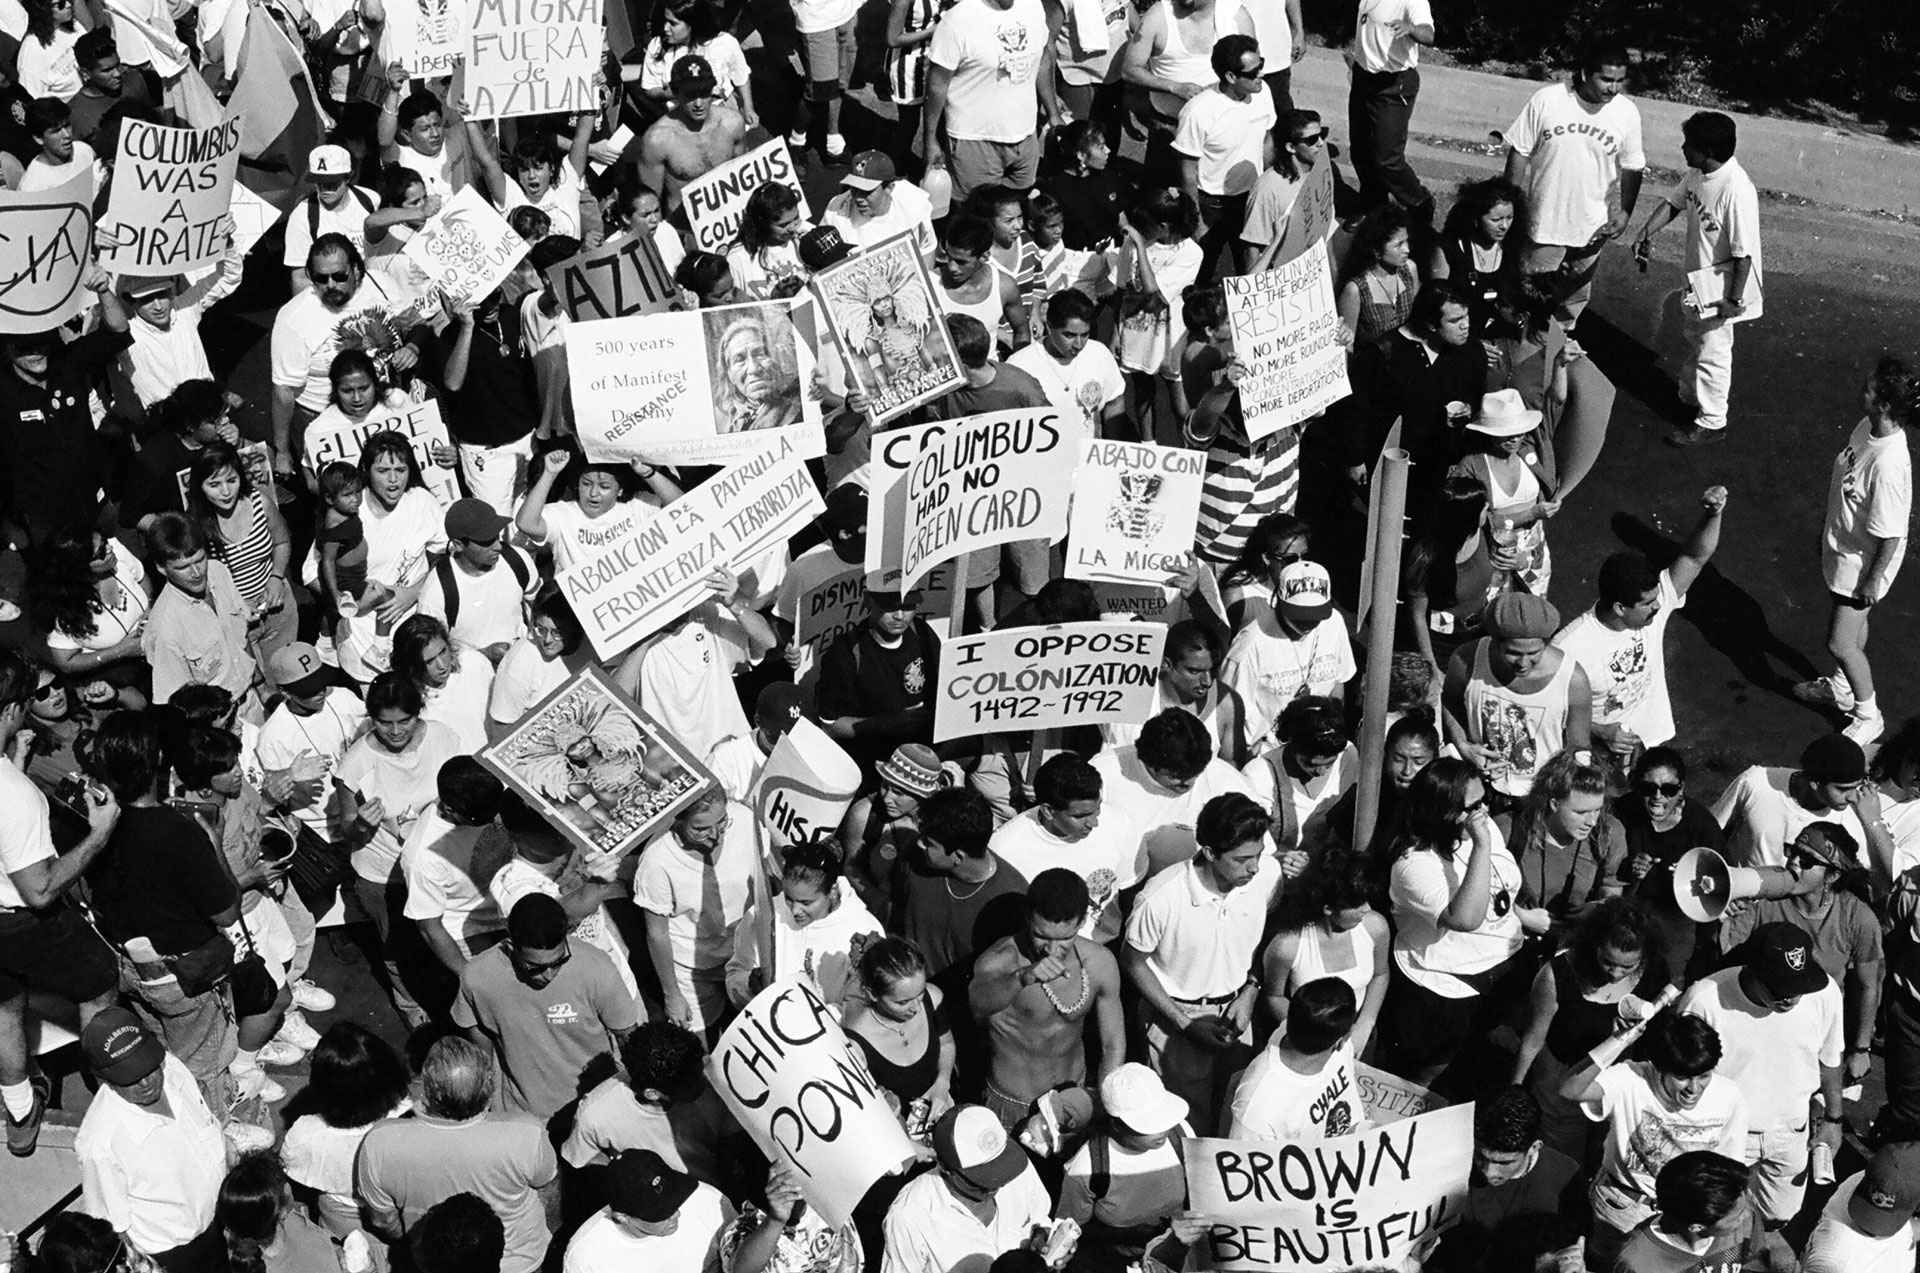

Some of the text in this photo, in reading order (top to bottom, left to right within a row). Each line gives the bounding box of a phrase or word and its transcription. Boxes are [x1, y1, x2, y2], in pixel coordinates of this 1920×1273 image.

[473, 0, 598, 29] MIGRA
[473, 27, 588, 66] FUERA
[513, 61, 548, 82] de
[124, 115, 240, 164] COLUMBUS
[1542, 123, 1618, 156] security
[136, 163, 217, 193] WAS
[688, 147, 788, 221] FUNGUS
[161, 199, 188, 223] A
[111, 213, 228, 265] PIRATE
[485, 230, 522, 266] UVAS
[438, 268, 458, 291] NO
[1226, 277, 1251, 296] NO
[1254, 260, 1302, 291] BERLIN
[1242, 266, 1323, 309] AT THE BORDER
[595, 337, 675, 358] 500 years
[1253, 310, 1334, 359] NO MORE RAIDS
[590, 368, 688, 393] of Manifest
[1240, 366, 1297, 396] NO MORE
[1244, 363, 1264, 380] NO
[1268, 350, 1297, 372] MORE
[874, 371, 957, 414] RESISTANCE
[1243, 364, 1345, 421] NO MORE DEPORTATIONS
[603, 380, 688, 443] RESISTANCE
[910, 414, 1060, 500] COLUMBUS
[1086, 443, 1204, 475] ABAJO CON
[916, 463, 1000, 526] HAD NO
[567, 519, 669, 603] ABOLICION
[676, 512, 704, 534] LA
[710, 434, 794, 509] PATRULLA
[905, 487, 1042, 576] GREEN CARD
[592, 468, 812, 632] FRONTERIZA TERRORISTA
[1078, 548, 1107, 566] LA
[1106, 597, 1168, 611] WANTED
[298, 654, 312, 673] P
[957, 633, 1154, 666] I OPPOSE
[602, 777, 696, 850] RESISTANCE
[1309, 1065, 1350, 1125] CHALE
[1215, 1120, 1418, 1202] BROWN
[1316, 1198, 1358, 1228] IS
